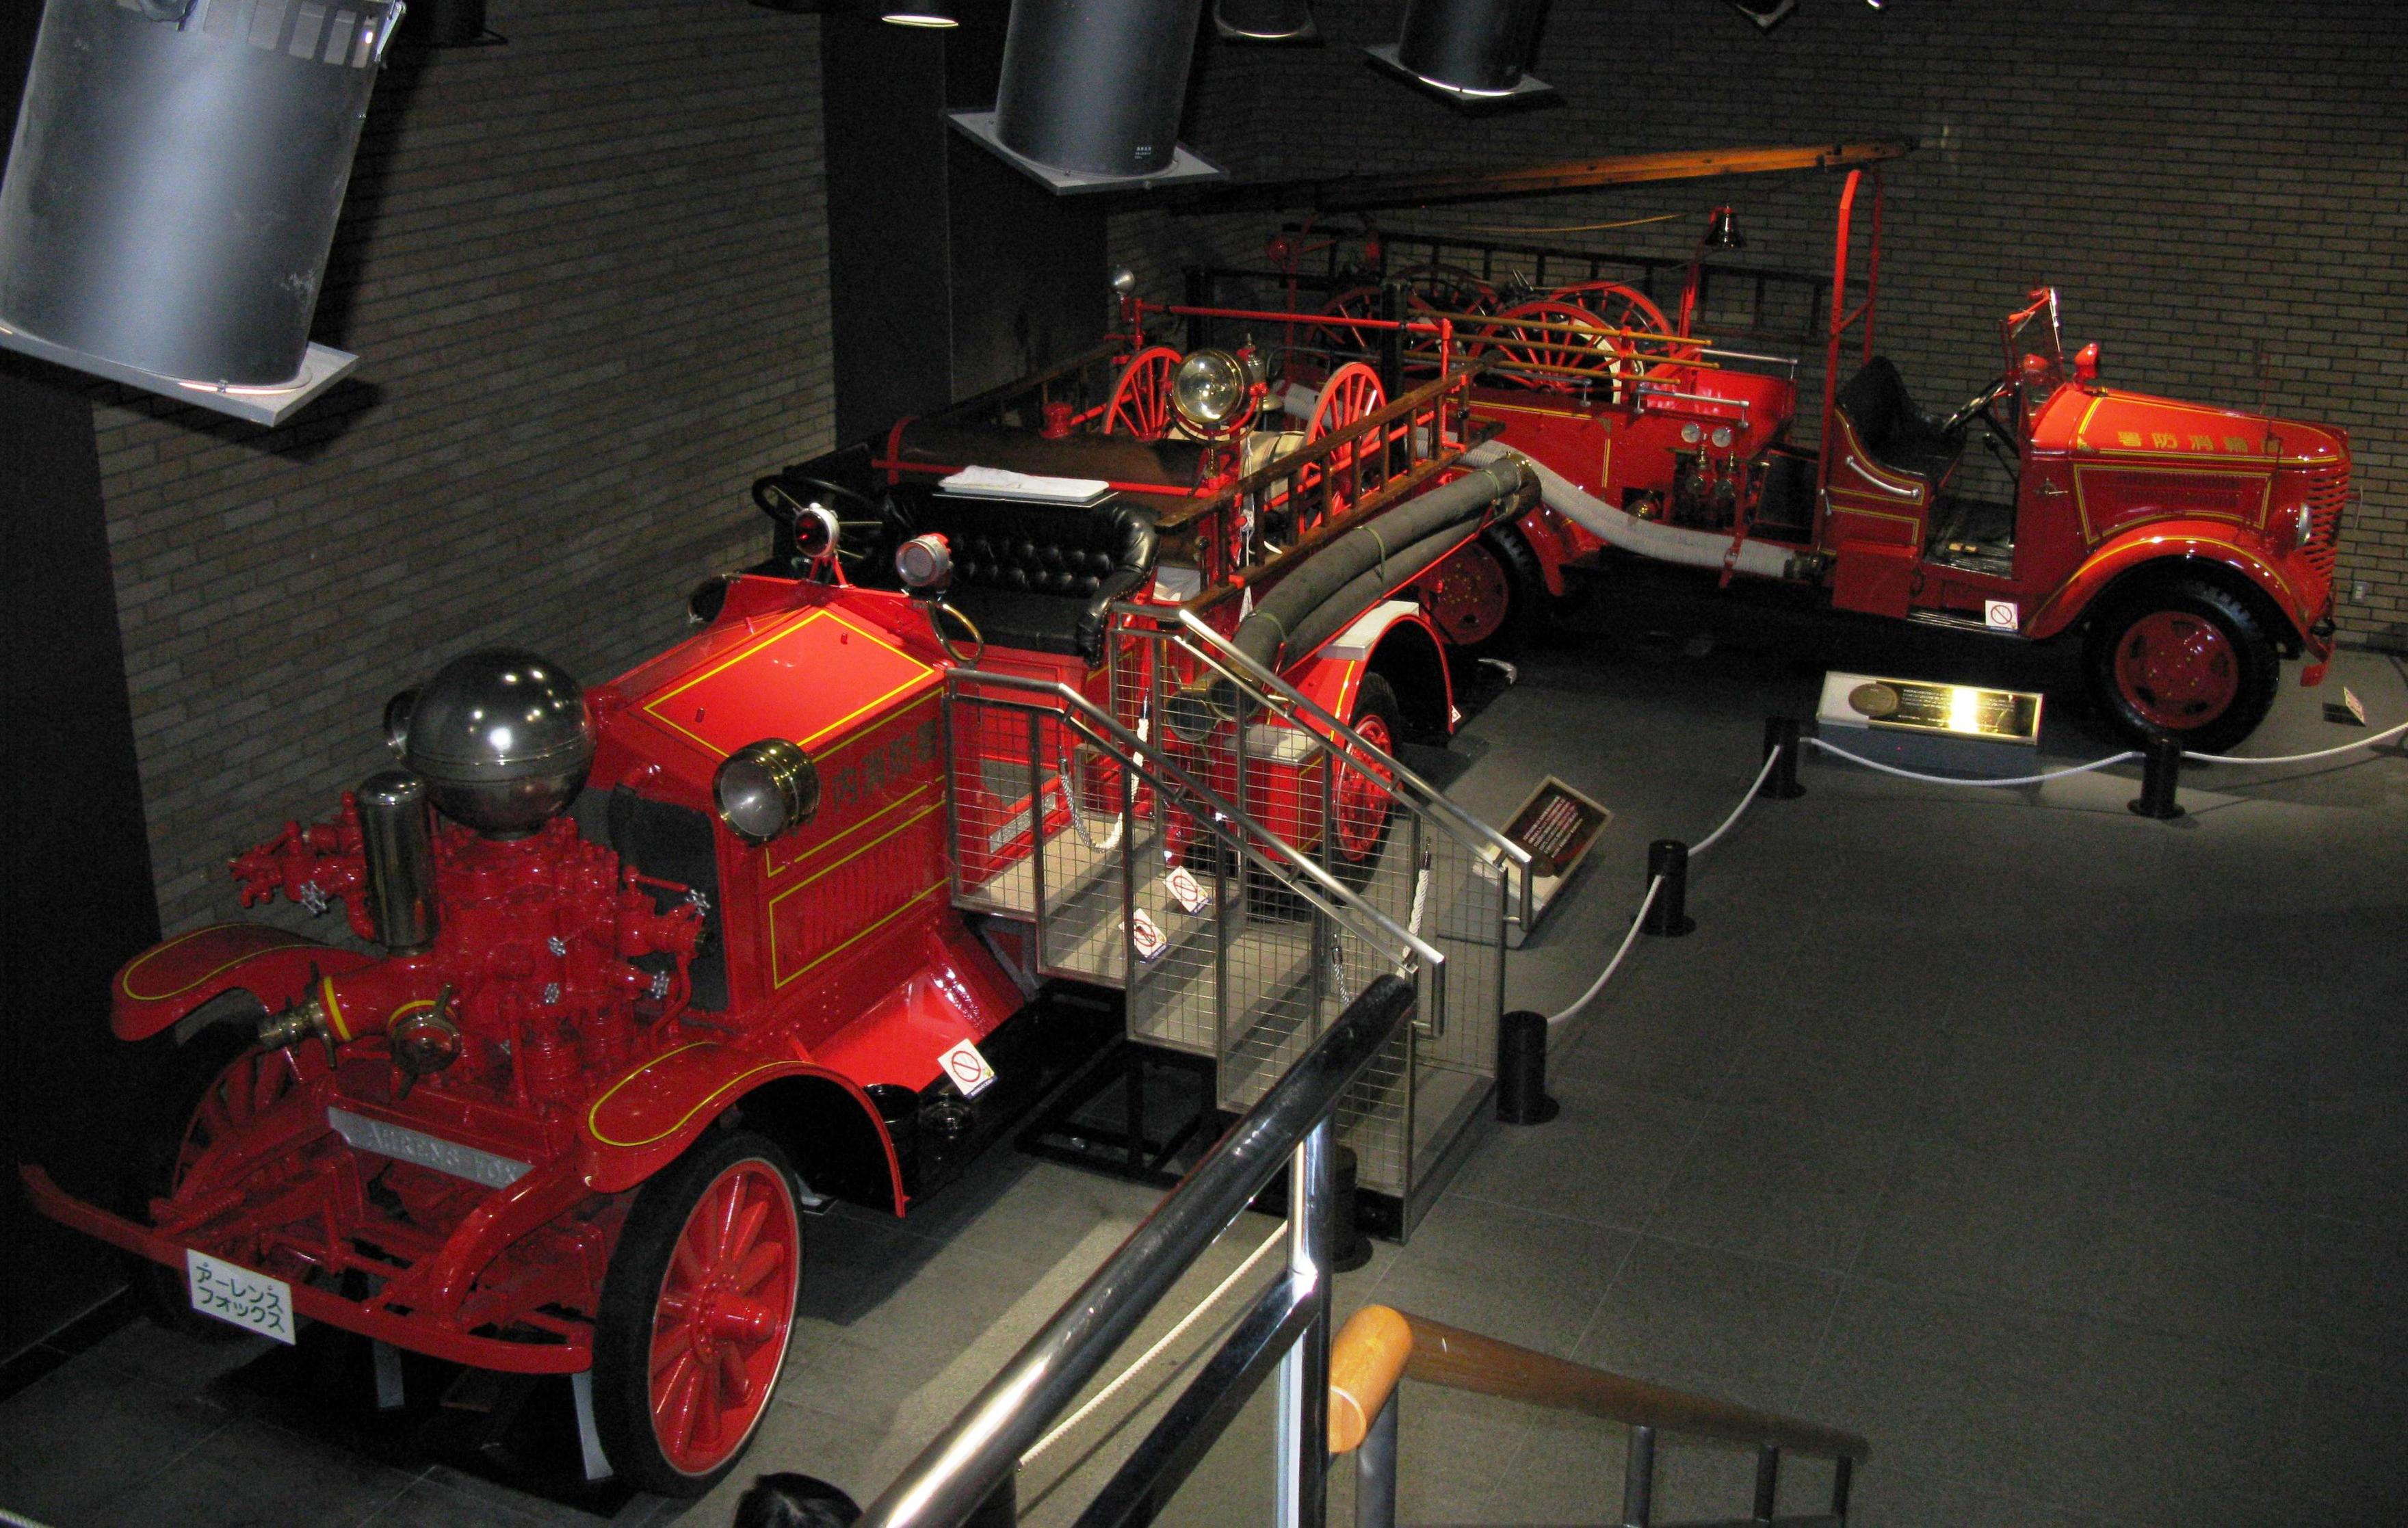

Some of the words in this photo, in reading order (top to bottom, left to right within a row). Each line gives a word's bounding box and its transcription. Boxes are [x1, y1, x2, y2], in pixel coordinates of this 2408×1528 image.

[196, 1265, 284, 1314] アーレンス
